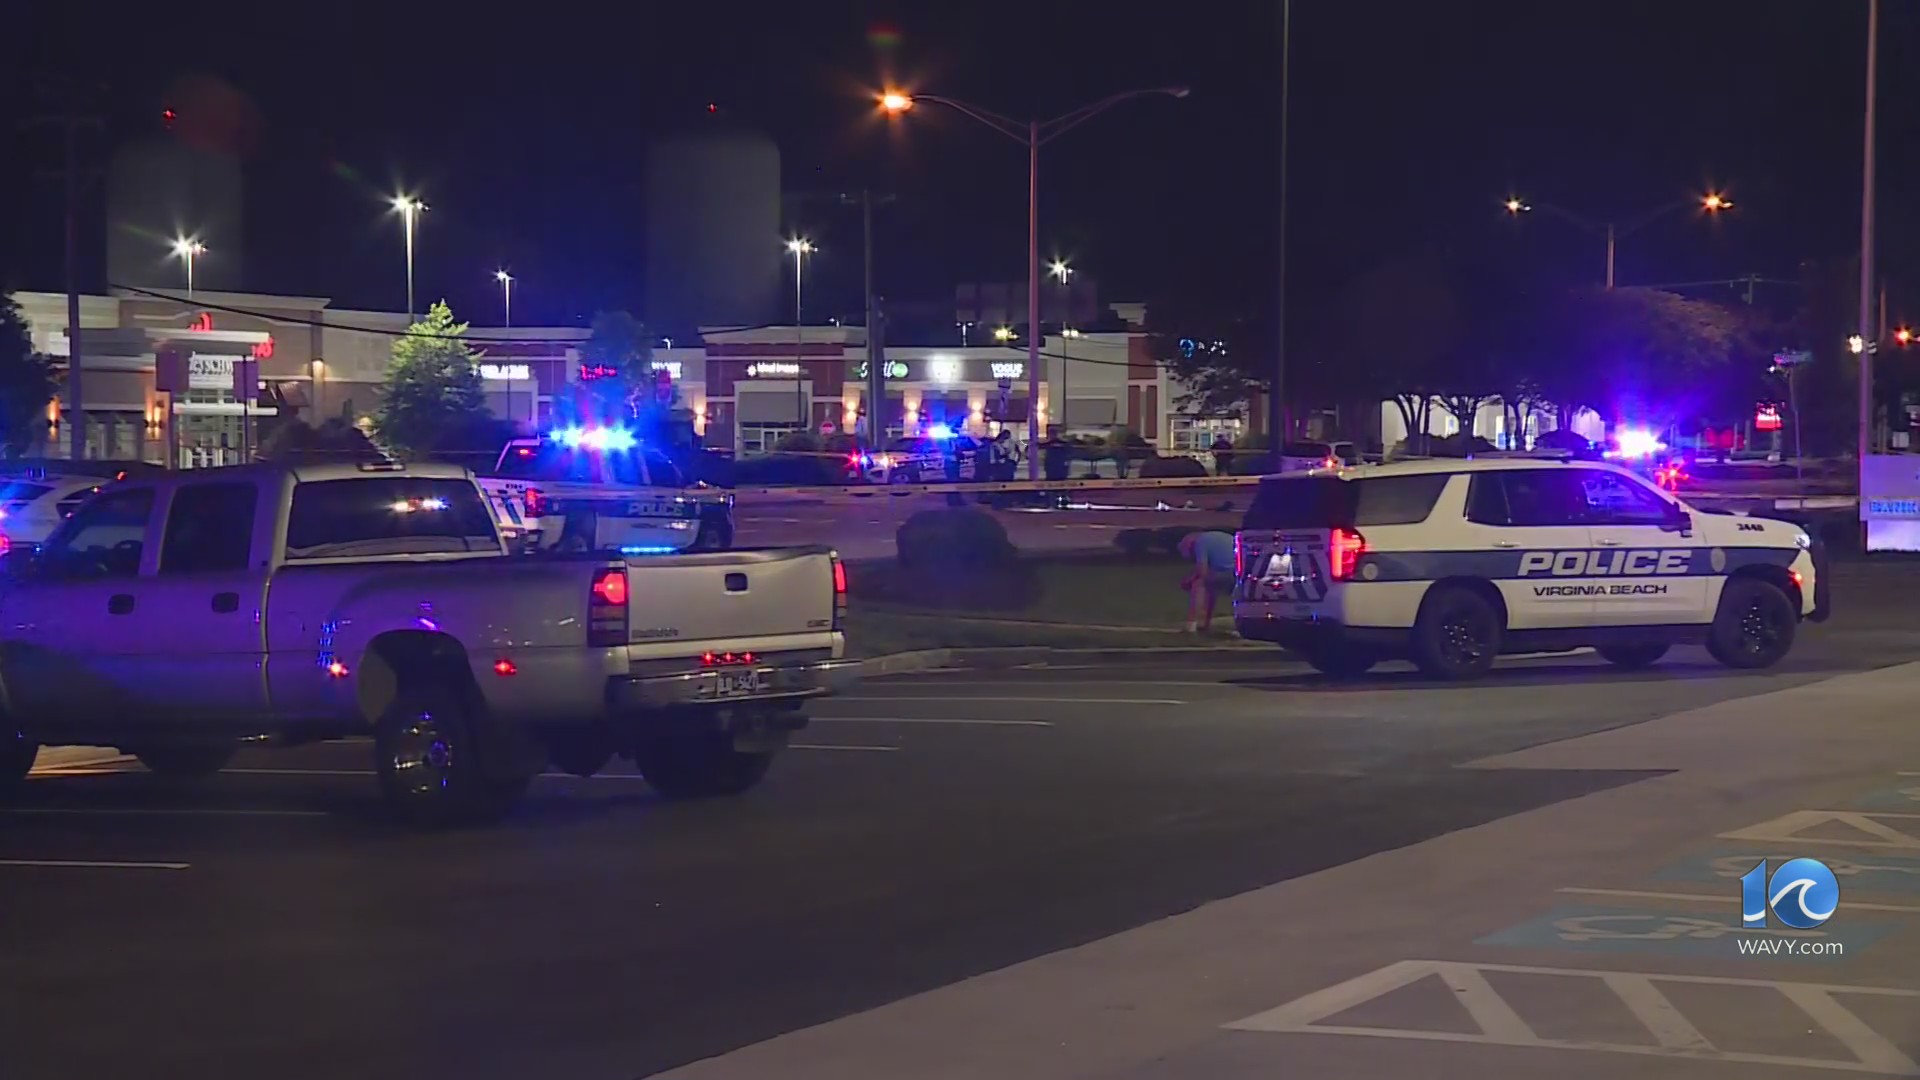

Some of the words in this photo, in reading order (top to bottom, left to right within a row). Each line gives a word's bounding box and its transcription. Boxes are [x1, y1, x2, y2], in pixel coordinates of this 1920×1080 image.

[627, 503, 684, 516] POLICE
[1517, 550, 1692, 577] POLICE
[1533, 585, 1607, 597] VIRGINIA
[1609, 584, 1668, 595] BEACH
